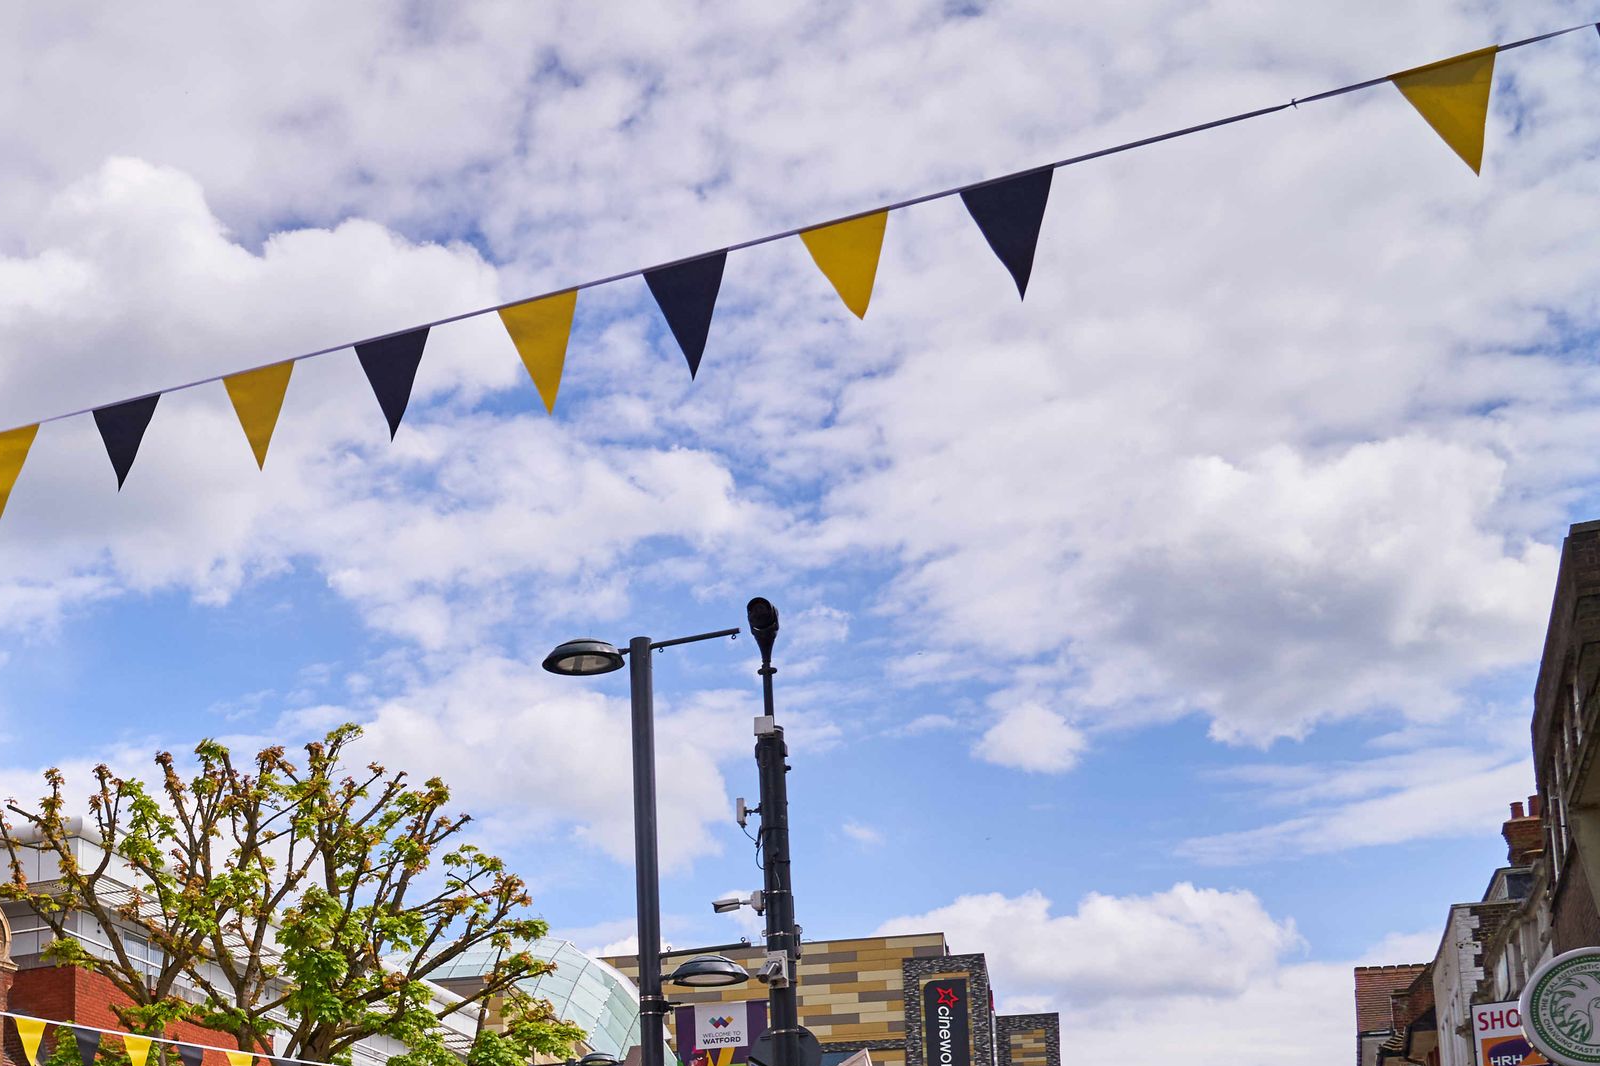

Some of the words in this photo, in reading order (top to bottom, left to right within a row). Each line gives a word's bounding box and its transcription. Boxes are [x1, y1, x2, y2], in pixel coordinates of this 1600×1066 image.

[1478, 1008, 1520, 1031] SHO
[702, 1036, 741, 1045] WATFORD
[1574, 1045, 1594, 1054] FAST
[1490, 1054, 1522, 1066] HRH
